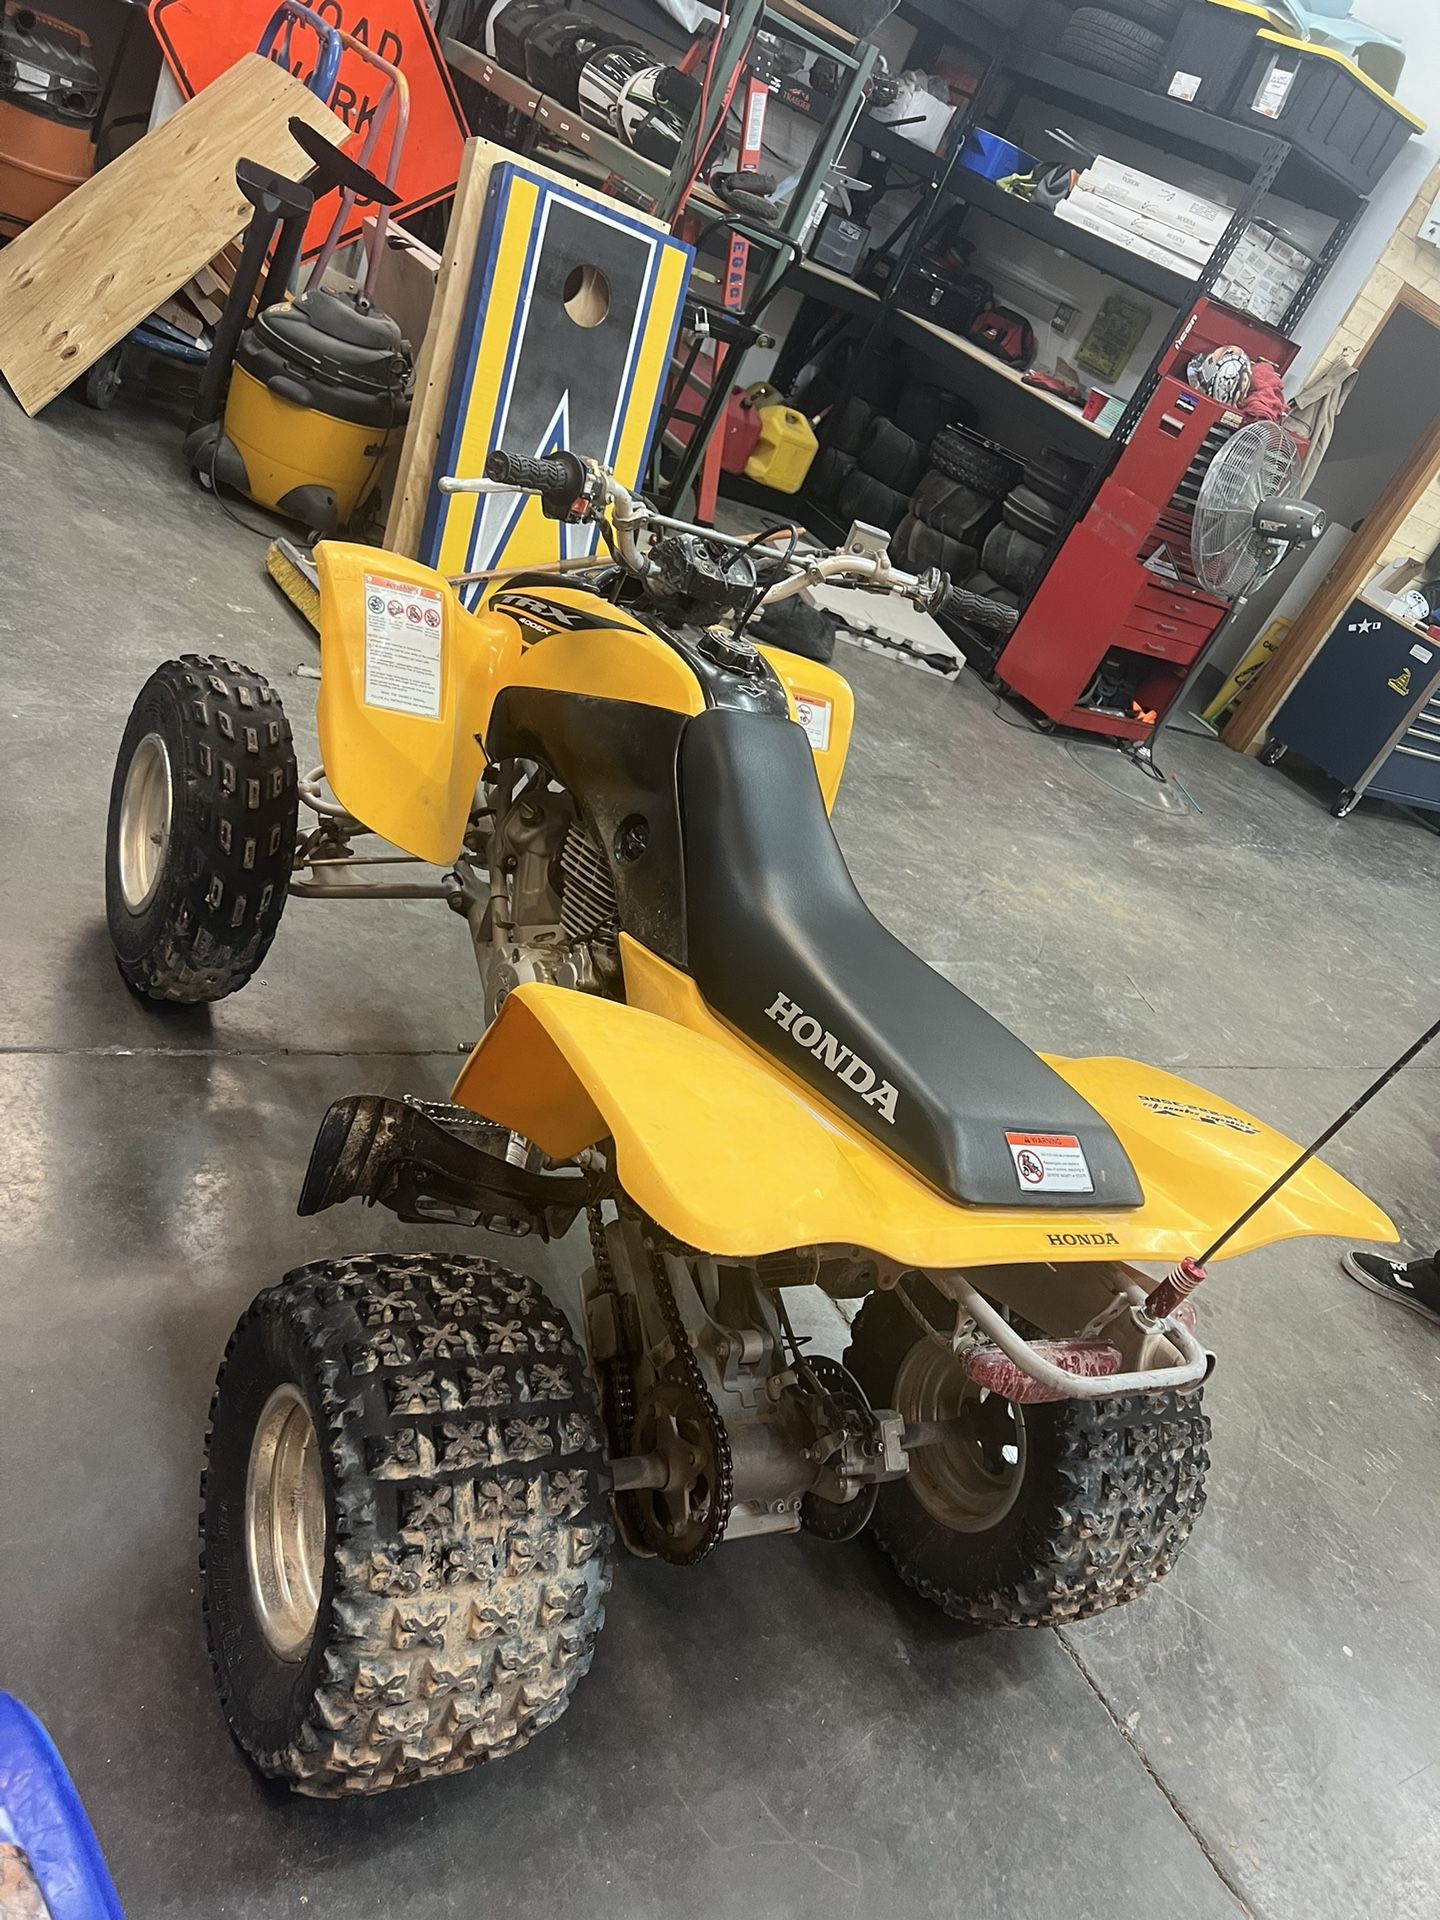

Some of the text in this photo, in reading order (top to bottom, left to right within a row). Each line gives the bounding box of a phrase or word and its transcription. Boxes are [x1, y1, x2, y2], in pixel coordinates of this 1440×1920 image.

[297, 0, 402, 69] OAD
[501, 595, 583, 626] TRX
[518, 617, 551, 635] 400EX
[764, 991, 899, 1124] HONDA
[1031, 1136, 1062, 1145] WARNING
[1046, 1232, 1119, 1246] HONDA
